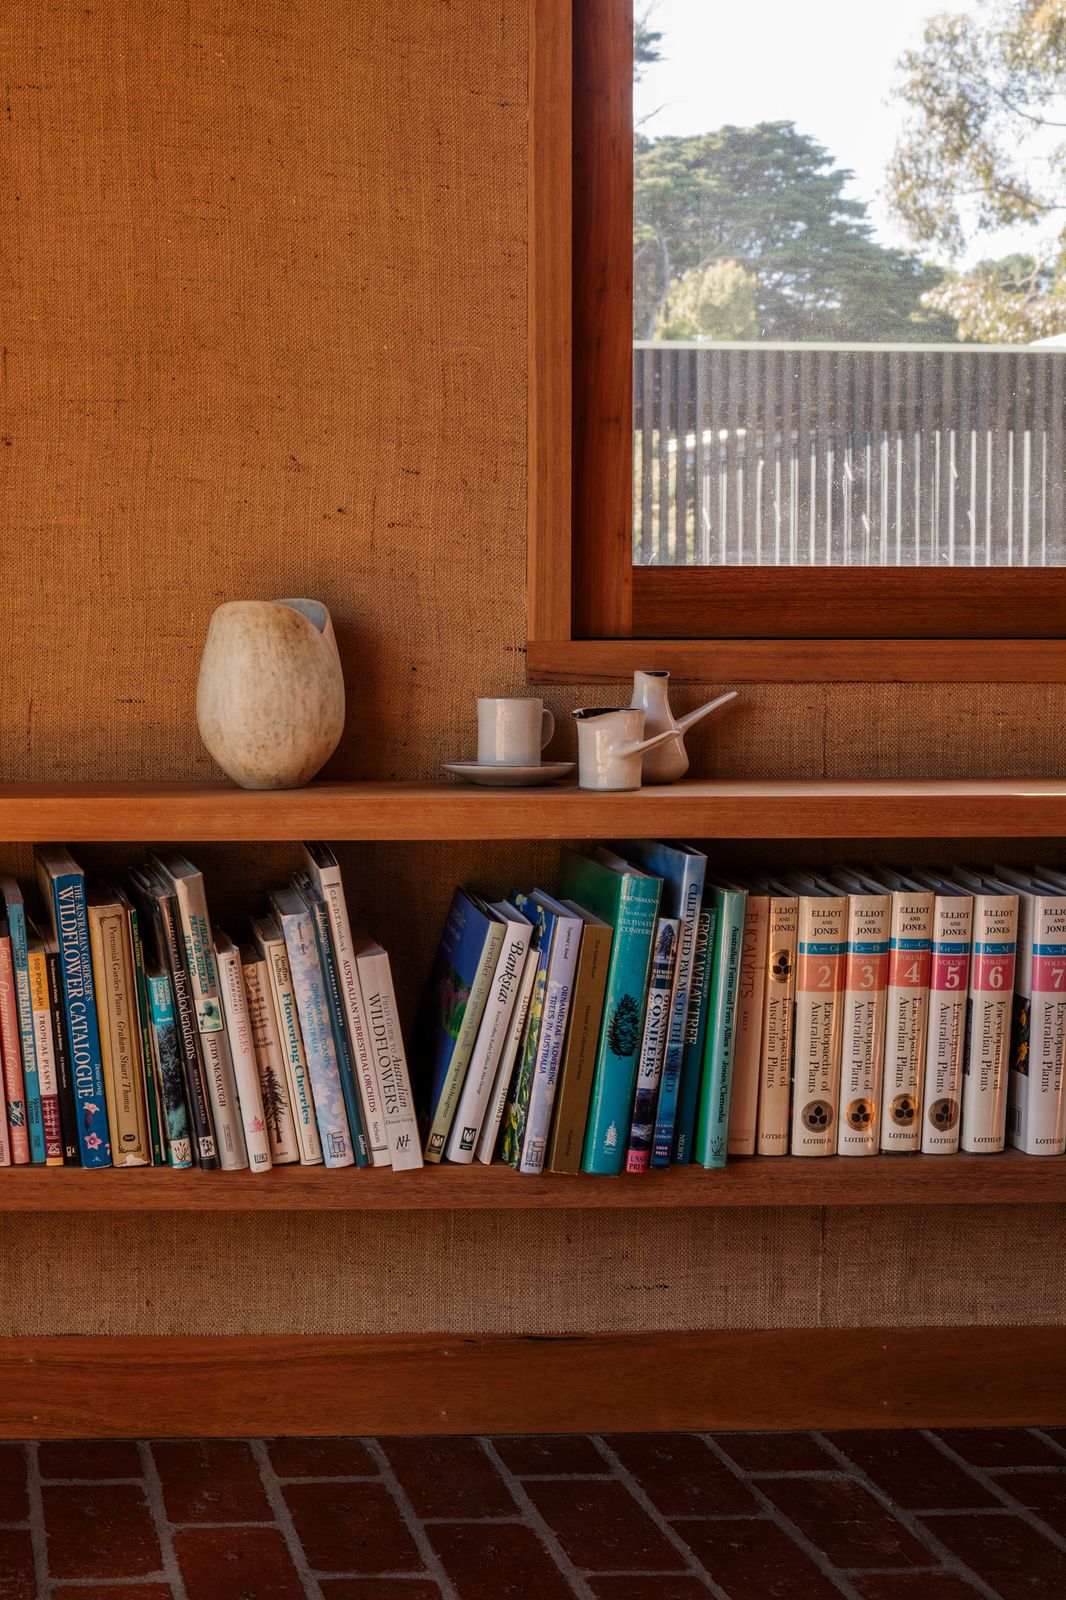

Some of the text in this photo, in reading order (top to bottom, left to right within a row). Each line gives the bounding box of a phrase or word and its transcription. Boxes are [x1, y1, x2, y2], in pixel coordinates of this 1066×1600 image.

[74, 884, 93, 1001] THE AUSTRALIAN GARDENER'S
[185, 936, 196, 976] IS THAT?
[190, 914, 208, 994] PEST DISEASE
[199, 918, 216, 988] WHAT GARDEN
[318, 911, 340, 1005] Hydrangeas GARDENER'S
[741, 912, 758, 998] EUCALYPTS
[813, 928, 838, 936] JONES
[901, 924, 926, 932] JONES
[941, 928, 967, 937] JONES
[36, 973, 44, 1007] POPULAR
[58, 885, 94, 1098] WILDFLOWER CATALOGUE
[109, 926, 123, 1016] Perennial Garden Plants
[158, 981, 166, 1012] CONIFERS
[168, 917, 177, 952] Gardening
[174, 970, 196, 1060] Rhododendrons
[228, 967, 238, 1012] HANDBOOKS
[234, 967, 244, 1011] EYEWITNESS
[280, 956, 289, 982] Geoffrey
[461, 937, 500, 1050] Lavender the grower's guide
[498, 941, 525, 1004] Banksias
[666, 883, 698, 1092] CULTIVATED PALMS OF THE WORLD
[684, 913, 710, 1044] GROW WHAT TREE
[818, 965, 831, 987] 2
[860, 965, 874, 987] 3
[904, 961, 920, 982] 4
[945, 966, 960, 988] 5
[989, 966, 1003, 988] 6
[1052, 967, 1064, 988] 7
[0, 981, 17, 1096] Ornamental Grasses
[17, 970, 35, 1072] AUSTRALIAN PLANTS
[39, 1015, 48, 1057] TROPICAL
[236, 1019, 249, 1054] TREES
[305, 1001, 319, 1054] IN AUSTRALIA
[312, 983, 330, 1068] ORNAMENTAL PLANTS
[343, 959, 377, 1112] AUSTRALIAN TERRESTRIAL ORCHIDS
[518, 996, 529, 1024] ELLIOTT
[547, 996, 558, 1019] TREES
[548, 985, 568, 1085] ORNAMENTAL FLOWERING
[645, 994, 662, 1078] CONIFERS
[654, 994, 670, 1075] ORNAMENTAL
[718, 926, 740, 1123] Australian Ferns and Fern Allies Jones/Clemesha
[767, 998, 779, 1088] Australian Plants
[821, 1002, 834, 1076] Encyclopaedia
[896, 997, 910, 1088] Australian Plants
[909, 997, 922, 1071] Encyclopaedia
[950, 1002, 962, 1076] Encyclopaedia
[1054, 1002, 1066, 1076] Encyclopaedia
[43, 1060, 51, 1090] PLANTS
[117, 1021, 131, 1113] Graham Stuart Thomas
[207, 1038, 226, 1107] JUDY McMAUGH
[283, 993, 311, 1124] Flowering Cherries
[368, 993, 399, 1114] WILDFLOWERS
[382, 995, 408, 1108] FIELD GUIDE TO Australian
[539, 1033, 552, 1074] AUSTRALIA
[808, 1001, 821, 1093] Australian Plants
[851, 1001, 865, 1092] Australian Plants
[864, 1001, 876, 1091] Encyclopaedia of
[936, 1002, 951, 1093] Australian Plants
[980, 1001, 994, 1092] Australian Plants
[992, 1001, 1006, 1090] Encyclopaedia of
[1041, 1002, 1054, 1093] Australian Plants
[197, 1096, 206, 1124] RICHARDS
[443, 1061, 464, 1118] Virginia McNaughton
[495, 1088, 508, 1123] LEWISIAS
[358, 1134, 366, 1155] Lothian
[372, 1122, 382, 1142] Nelson
[677, 1134, 685, 1160] NELSON
